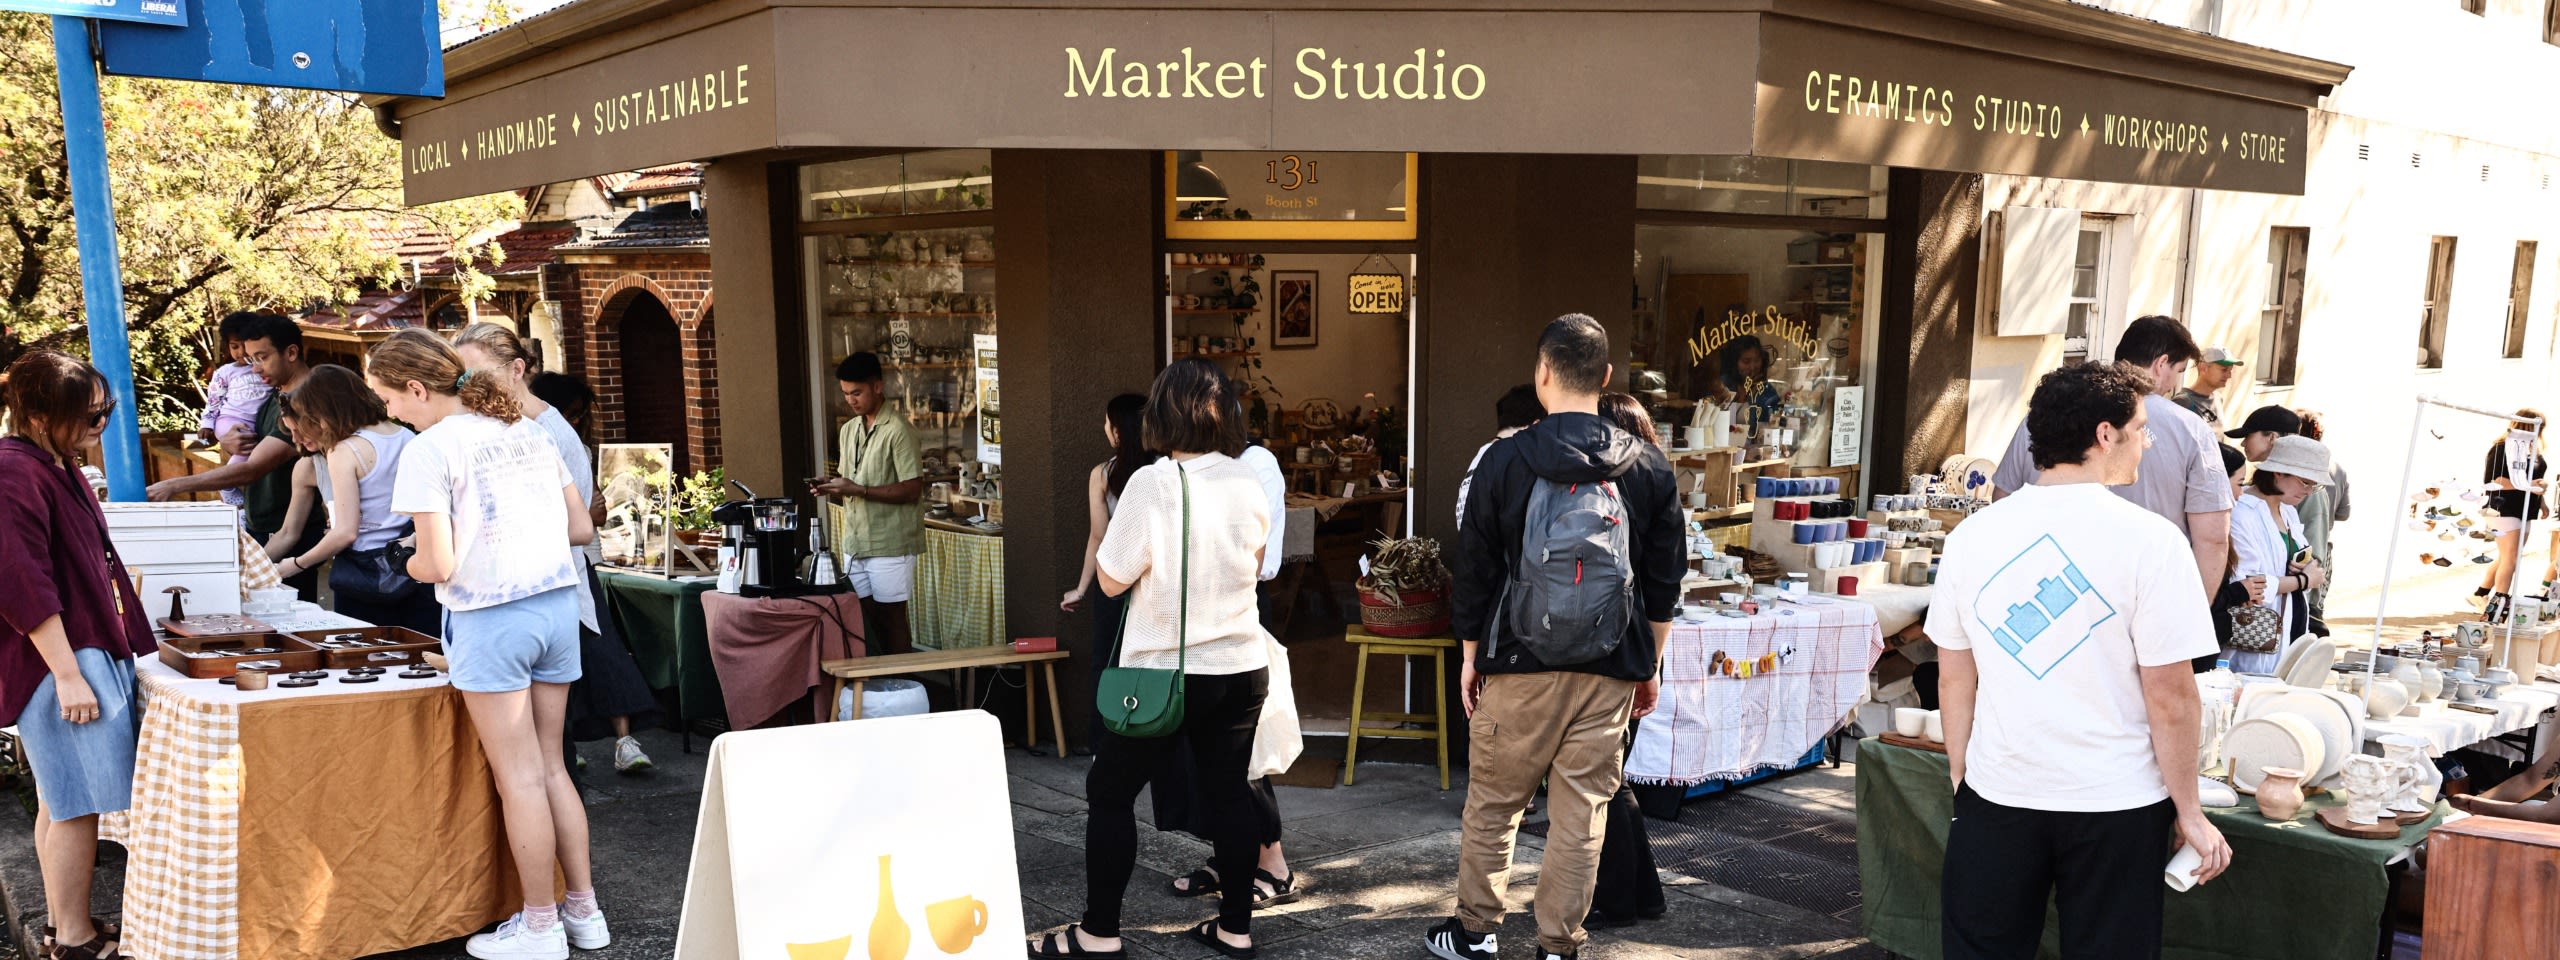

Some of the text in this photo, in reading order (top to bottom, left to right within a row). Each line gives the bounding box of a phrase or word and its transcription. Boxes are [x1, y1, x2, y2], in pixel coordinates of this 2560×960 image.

[141, 2, 178, 13] LIBERAL
[1064, 47, 1486, 100] Market Studio
[412, 64, 749, 175] LOCAL HANDMADE SUSTAINABLE
[1805, 71, 2286, 164] CERAMICS STUDIO WORKSHOPS STORE
[1266, 154, 1319, 191] 131
[1265, 194, 1318, 208] Booth St
[1353, 291, 1399, 309] OPEN
[1354, 280, 1372, 290] Come
[1687, 304, 1818, 368] Market Studio
